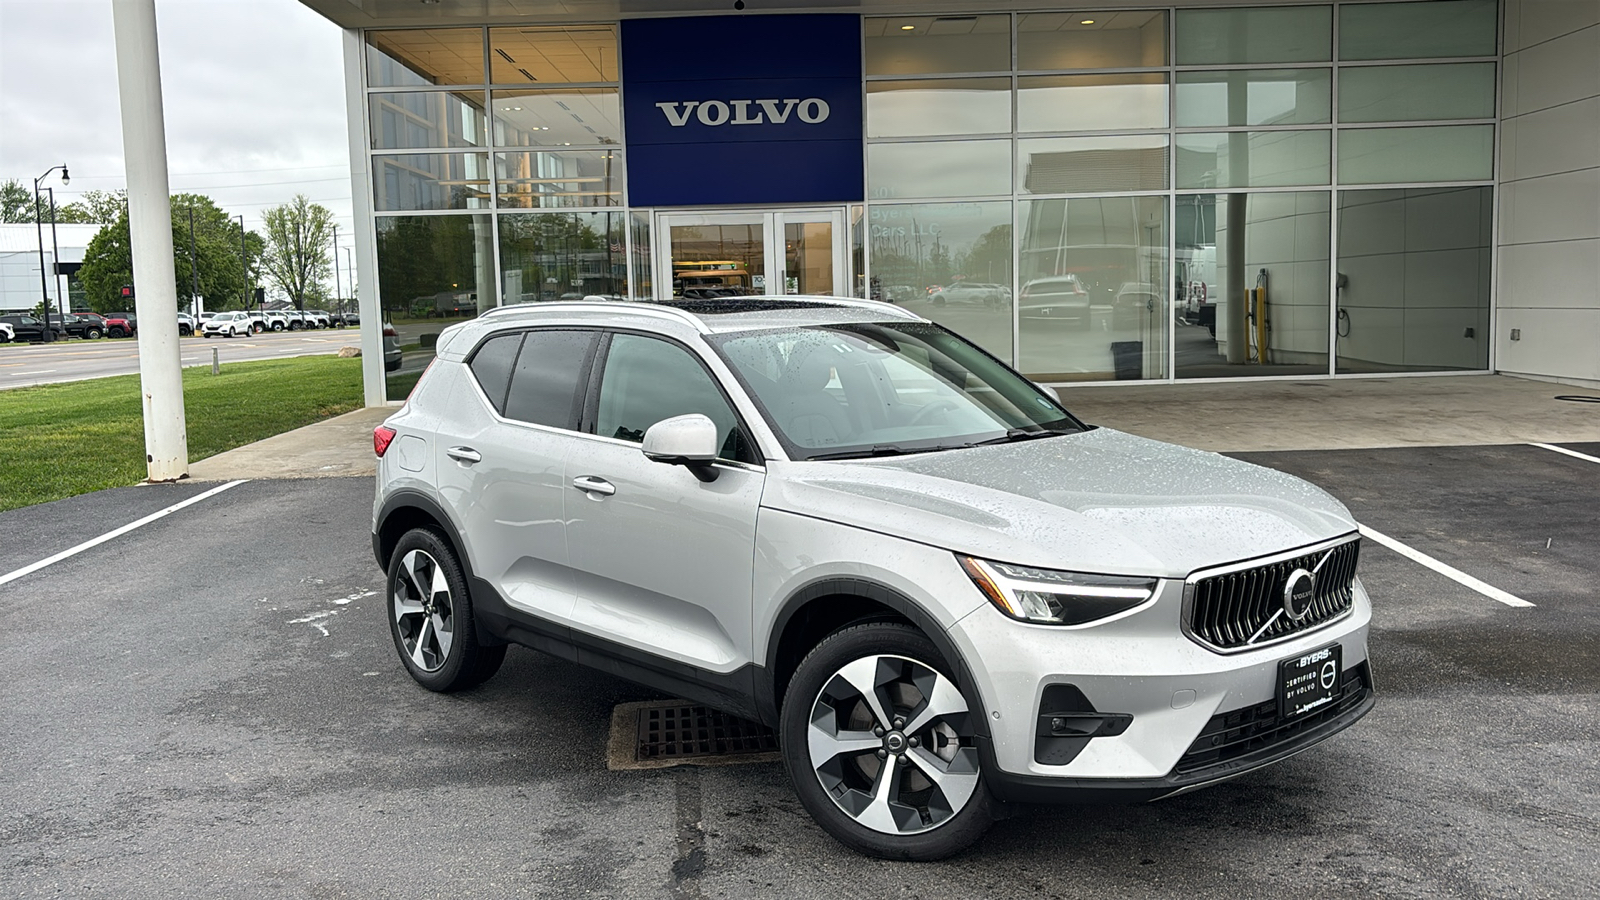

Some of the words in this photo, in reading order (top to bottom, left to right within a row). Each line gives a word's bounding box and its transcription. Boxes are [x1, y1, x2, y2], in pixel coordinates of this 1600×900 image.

[655, 98, 830, 127] VOLVO
[871, 207, 912, 222] Byers
[871, 224, 906, 237] Cars
[911, 222, 940, 236] LLC
[1299, 649, 1330, 668] BYERS
[1286, 671, 1317, 688] CERTIFIED
[1286, 690, 1295, 699] BY
[1296, 682, 1315, 695] VOLVO
